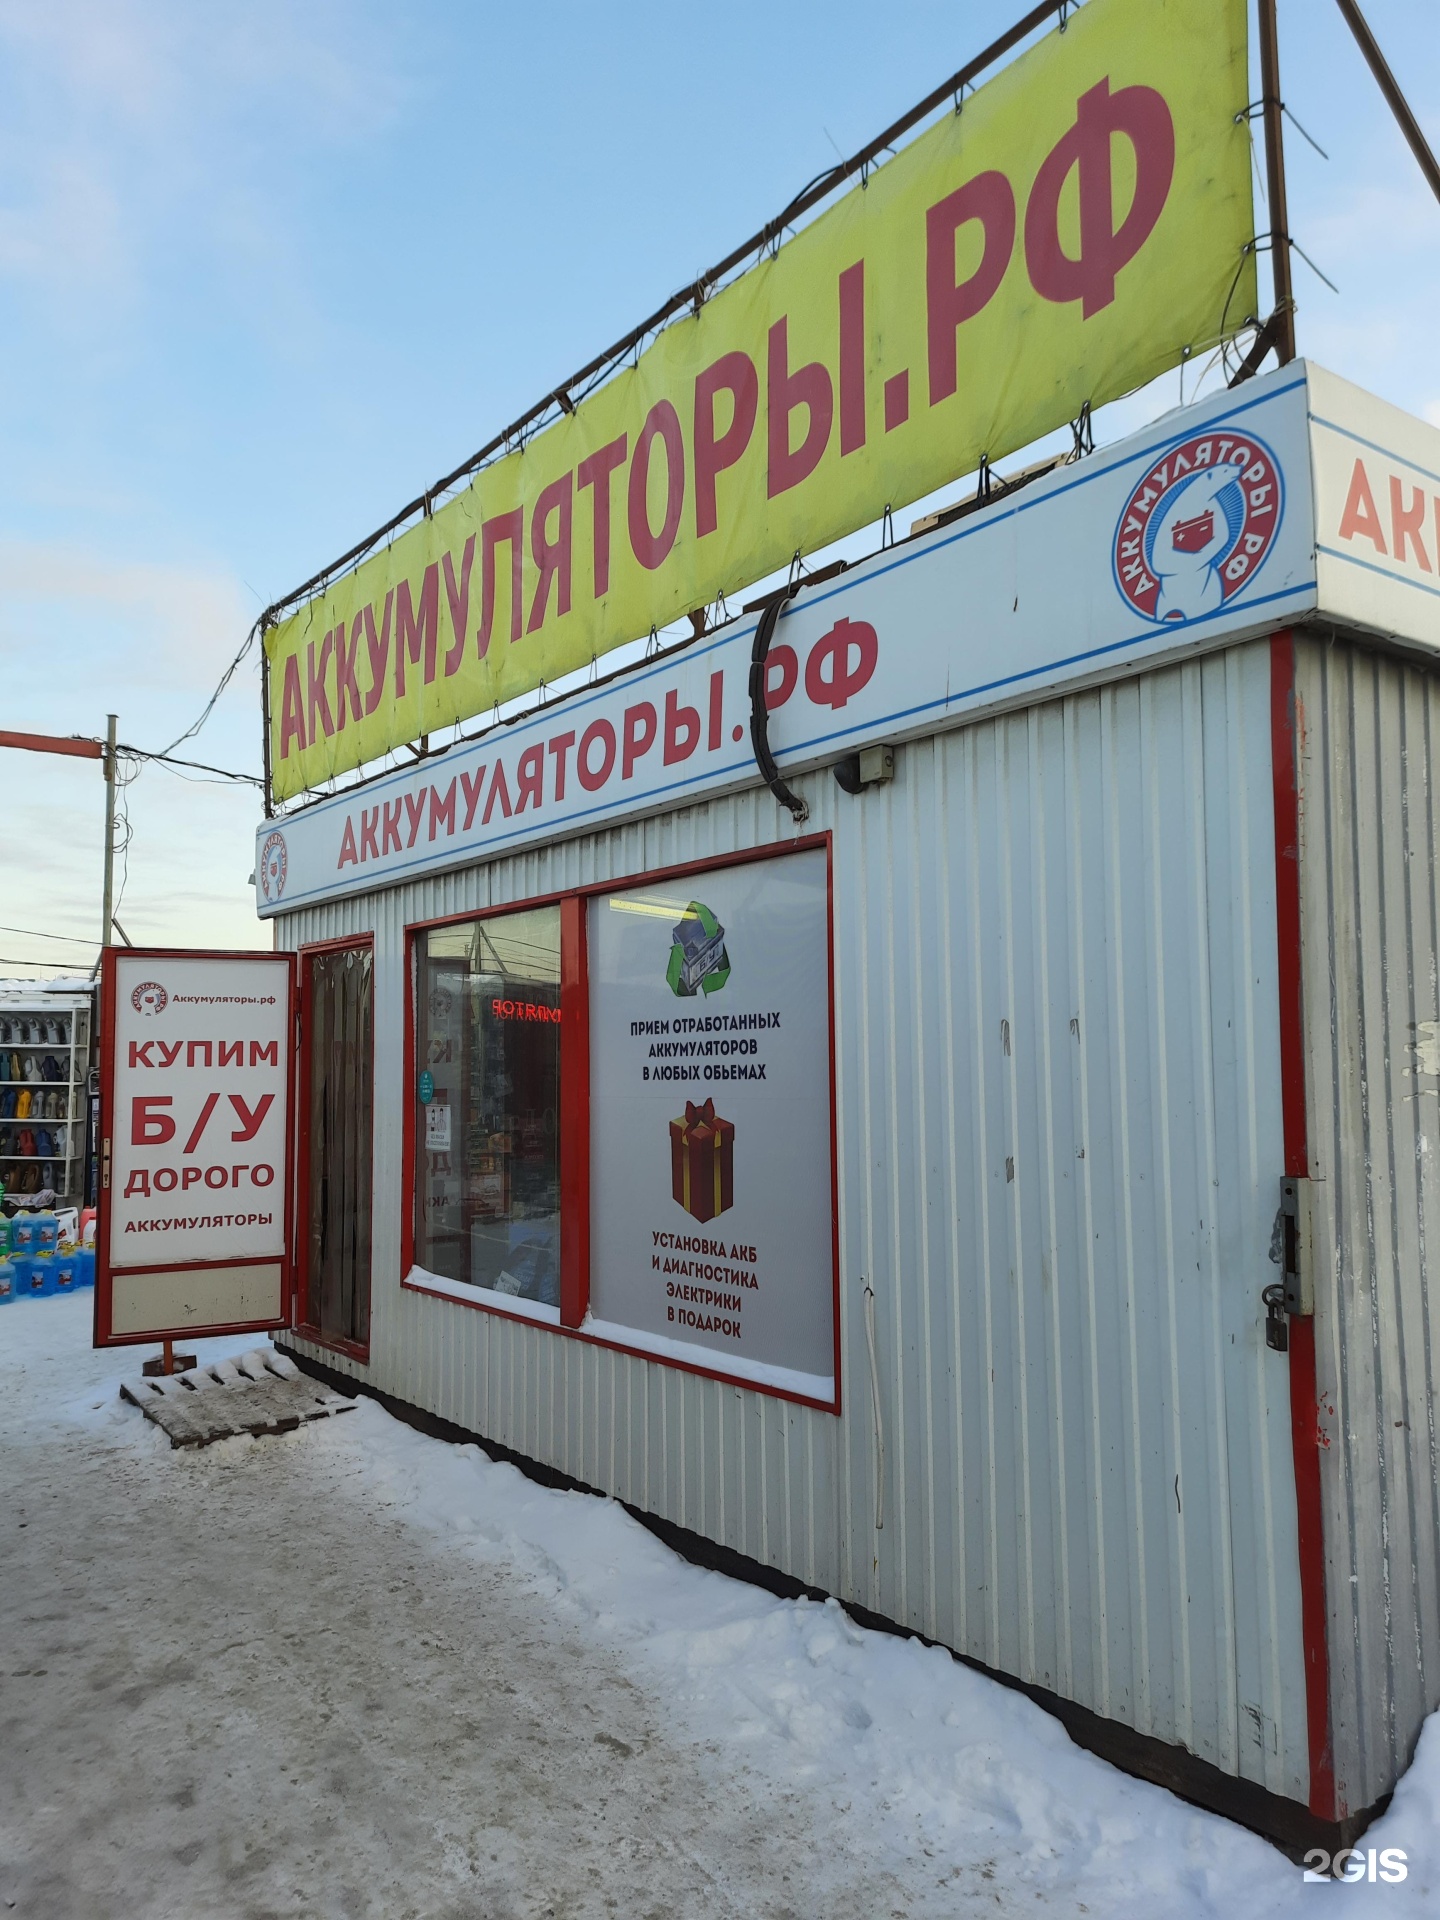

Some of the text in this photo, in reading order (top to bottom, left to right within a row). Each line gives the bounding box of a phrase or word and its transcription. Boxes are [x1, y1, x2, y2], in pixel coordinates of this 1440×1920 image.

[279, 75, 1175, 759] АККУМУЛЯТОРЫ.РФ
[1121, 441, 1272, 597] АККУМУЛЯТОРЫ РФ
[1338, 457, 1440, 578] АК
[172, 994, 276, 1005] Аккумуляторы.рф
[630, 1012, 781, 1036] ПРИЕМ ОТРАБОТАННЫХ
[128, 1040, 278, 1068] КУПИМ
[648, 1038, 758, 1058] АККУМУЛЯТОРОВ
[642, 1066, 650, 1081] В
[652, 1065, 700, 1081] ЛЮБЫХ
[131, 1092, 276, 1154] Б/У
[123, 1163, 275, 1199] ДОРОГО
[124, 1212, 273, 1234] АККУМУЛЯТОРЫ
[652, 1231, 758, 1263] УСТАНОВКА АКБ
[652, 1254, 759, 1290] И ДИАГНОСТИКА
[666, 1281, 742, 1313] ЭЛЕКТРИКИ
[667, 1306, 742, 1339] В ПОДАРОК
